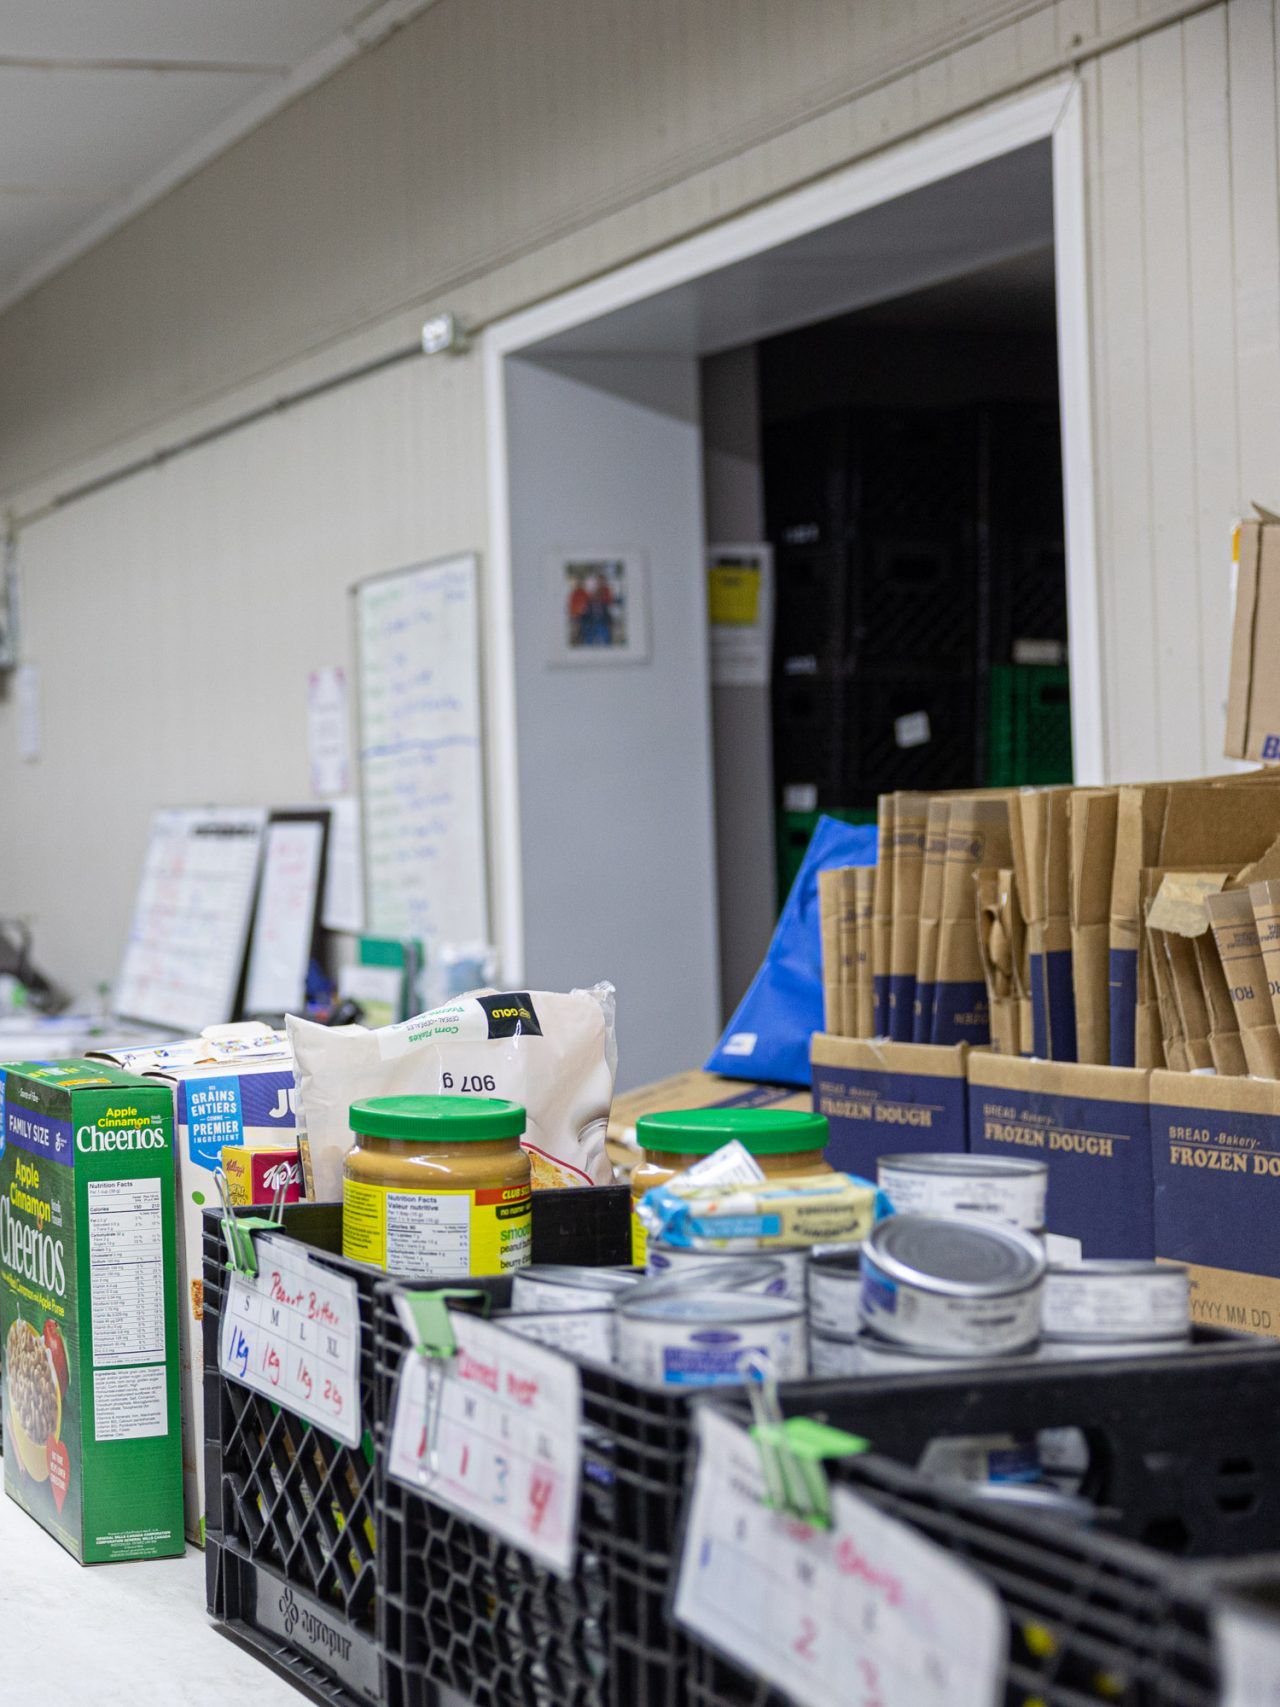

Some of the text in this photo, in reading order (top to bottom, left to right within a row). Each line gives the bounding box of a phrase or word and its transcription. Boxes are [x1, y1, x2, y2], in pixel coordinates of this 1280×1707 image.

[492, 1008, 519, 1019] GOLD
[408, 1026, 459, 1042] Corn Flakes
[442, 1072, 496, 1092] 907 g
[191, 1090, 235, 1105] GRAINS
[106, 1106, 138, 1118] Apple
[191, 1102, 237, 1117] ENTIERS
[821, 1096, 932, 1128] FROZEN DOUGH
[983, 1103, 1016, 1120] BREAD
[9, 1114, 50, 1147] FAMILY SIZE
[97, 1117, 151, 1128] Cinnamon
[193, 1121, 239, 1136] PREMIER
[76, 1125, 165, 1153] Cheerios
[984, 1122, 1114, 1157] FROZEN DOUGH
[1168, 1125, 1210, 1143] BREAD
[1169, 1145, 1248, 1173] FROZEN
[15, 1156, 40, 1189] Apple
[10, 1182, 51, 1223] Cinnamon
[388, 1194, 417, 1202] Nutrition
[502, 1188, 520, 1200] CLUB
[0, 1194, 66, 1296] Cheerios
[270, 1271, 304, 1307] Peanut
[1226, 1304, 1247, 1326] MM
[1251, 1308, 1272, 1329] DD
[244, 1295, 340, 1359] S M L XL
